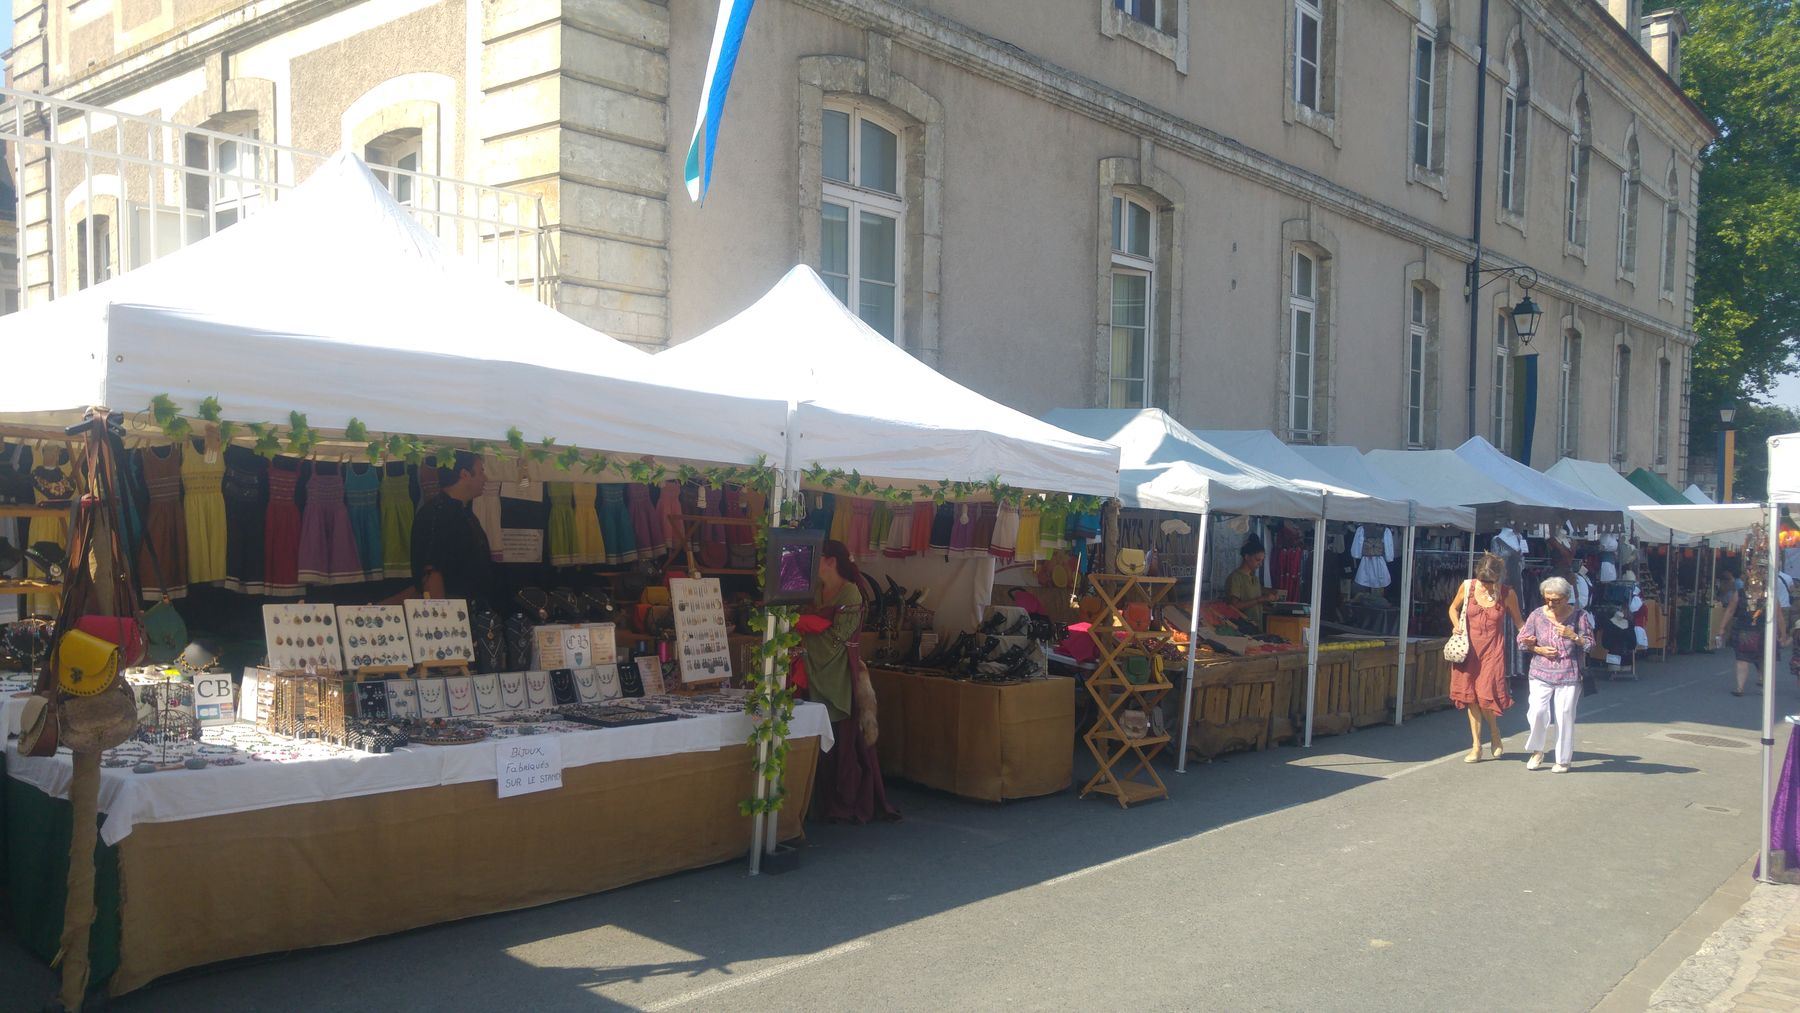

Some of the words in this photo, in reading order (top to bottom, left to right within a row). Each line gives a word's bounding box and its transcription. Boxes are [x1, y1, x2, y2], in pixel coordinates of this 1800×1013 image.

[197, 679, 231, 699] CB
[505, 777, 522, 789] SUR
[527, 776, 536, 785] LE
